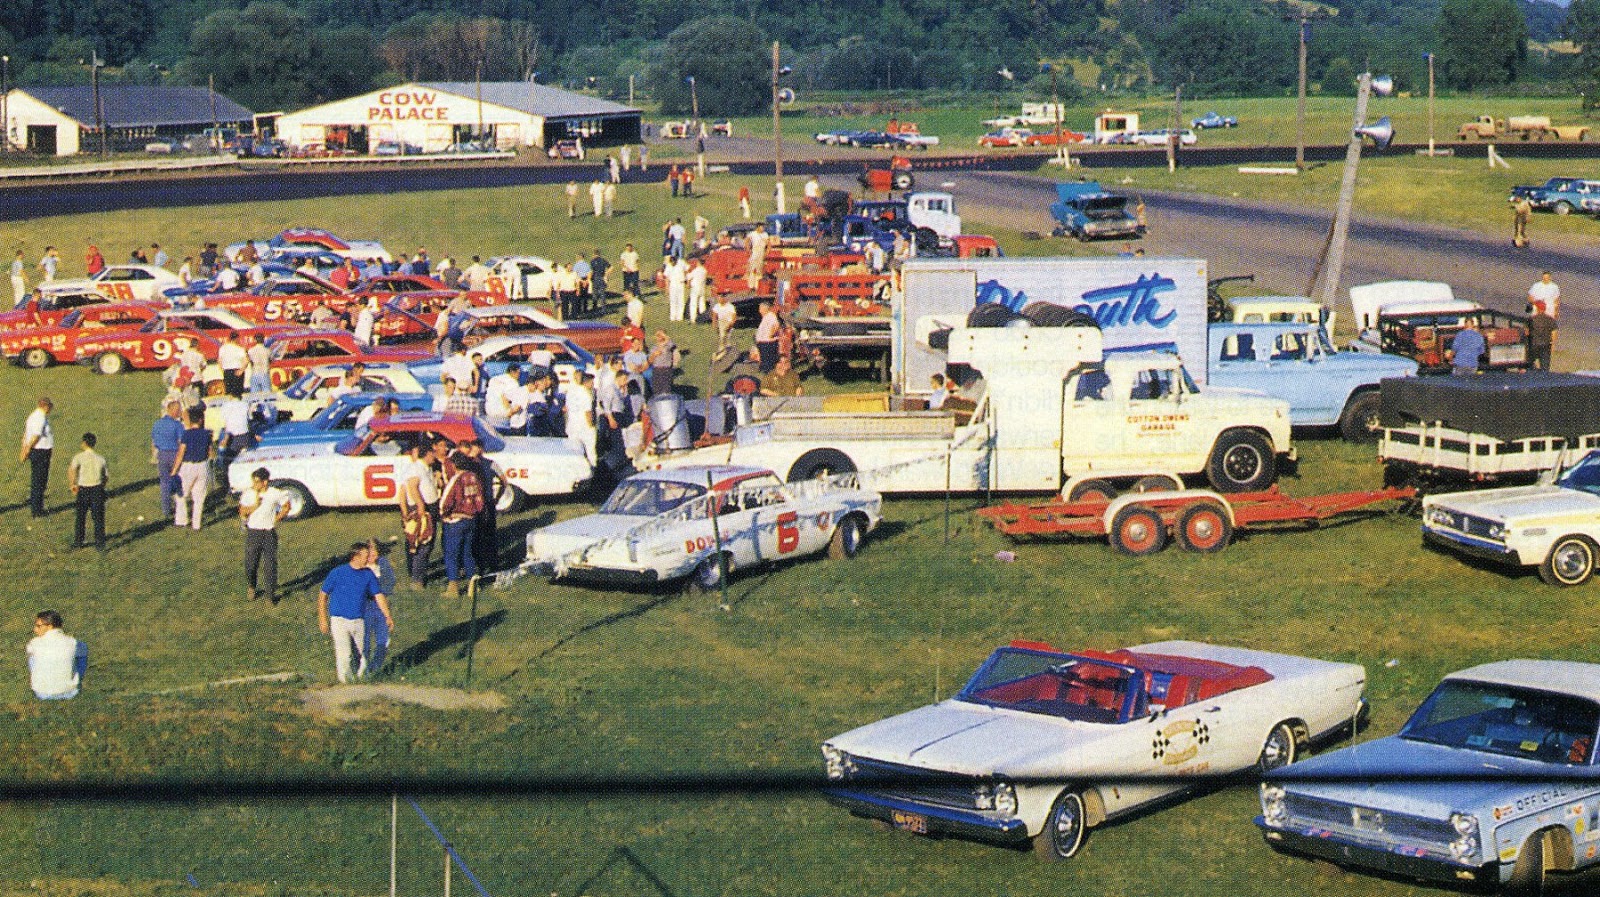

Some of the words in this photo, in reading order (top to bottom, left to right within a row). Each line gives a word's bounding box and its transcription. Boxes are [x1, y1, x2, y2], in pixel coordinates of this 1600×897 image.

[379, 92, 436, 105] COW
[368, 107, 449, 120] PALACE
[1141, 423, 1176, 431] GARAGE
[364, 464, 397, 499] 6
[777, 510, 800, 554] 6
